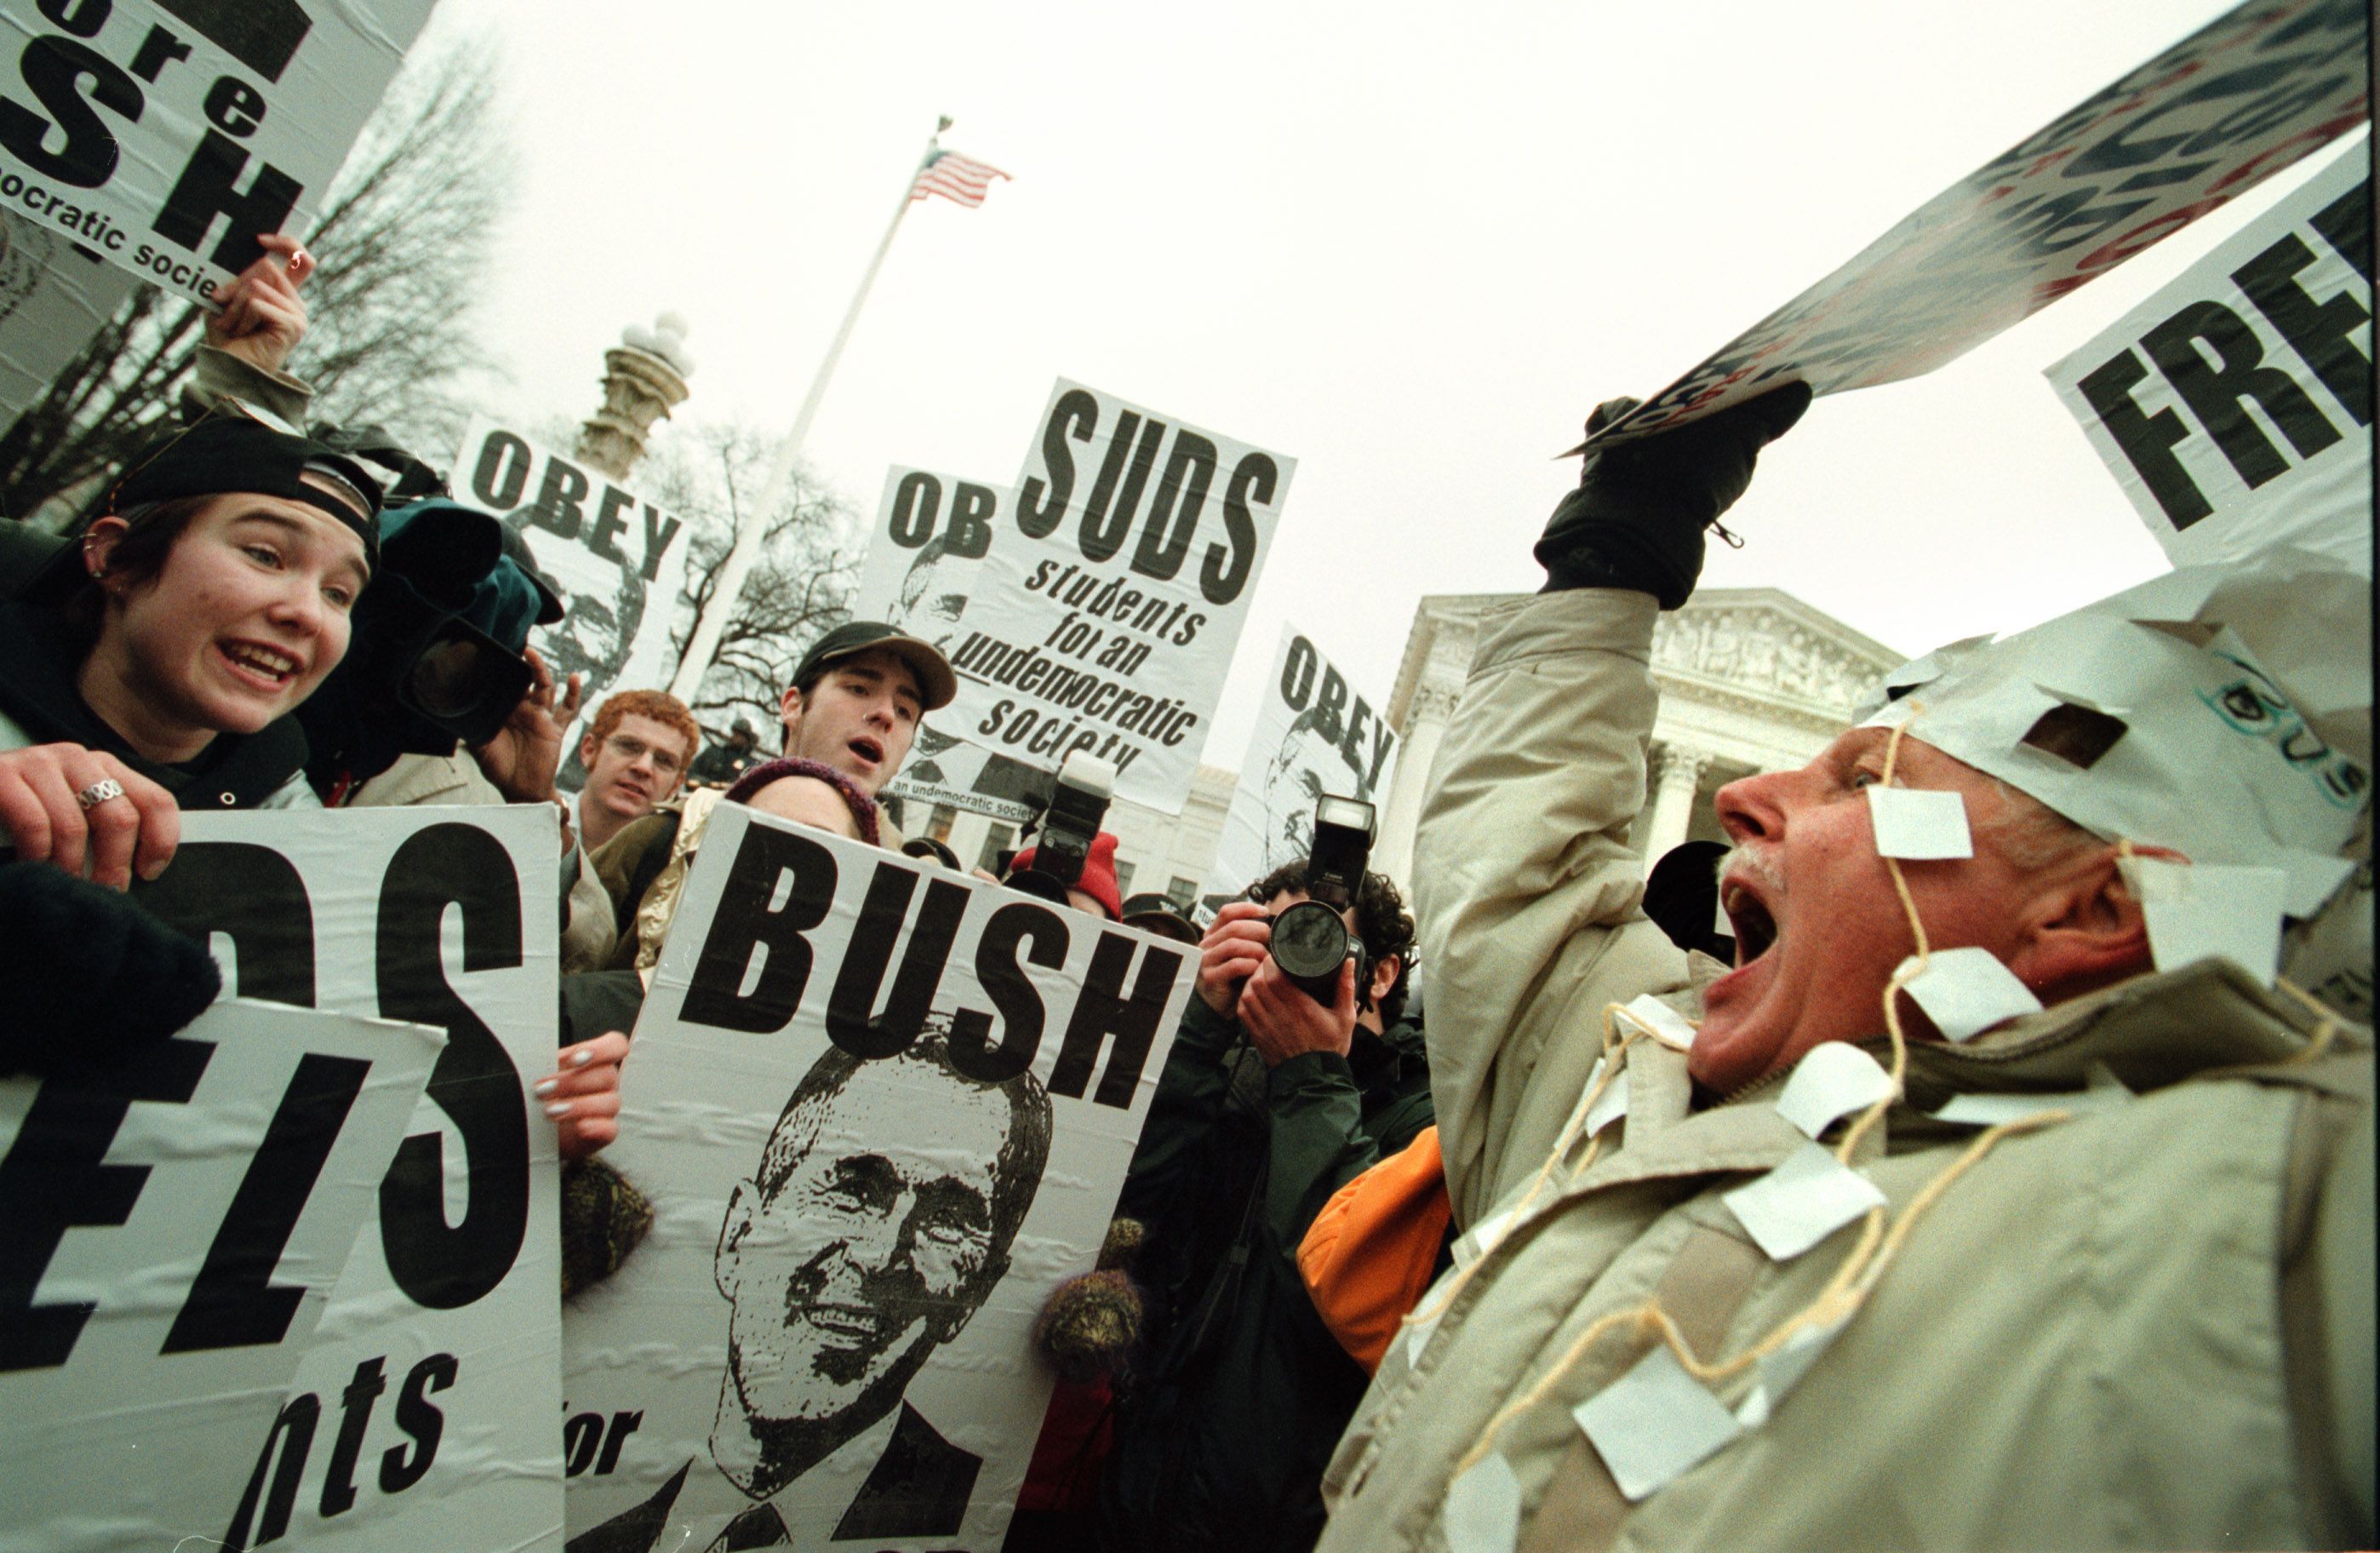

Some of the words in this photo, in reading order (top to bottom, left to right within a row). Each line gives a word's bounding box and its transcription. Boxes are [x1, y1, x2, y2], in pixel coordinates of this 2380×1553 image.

[472, 429, 682, 582] OBEY
[889, 472, 997, 559] OB
[1016, 388, 1279, 605] SUDS
[1024, 559, 1206, 646] students
[1044, 611, 1103, 660] for
[1096, 636, 1152, 676] an
[951, 632, 1198, 747] undemocratic
[1280, 635, 1394, 792] OBEY
[978, 699, 1141, 778] society
[894, 780, 908, 793] an
[912, 783, 993, 811] undemocratic
[996, 803, 1039, 821] societ
[678, 821, 1184, 1110] BUSH
[563, 1401, 644, 1478] or
